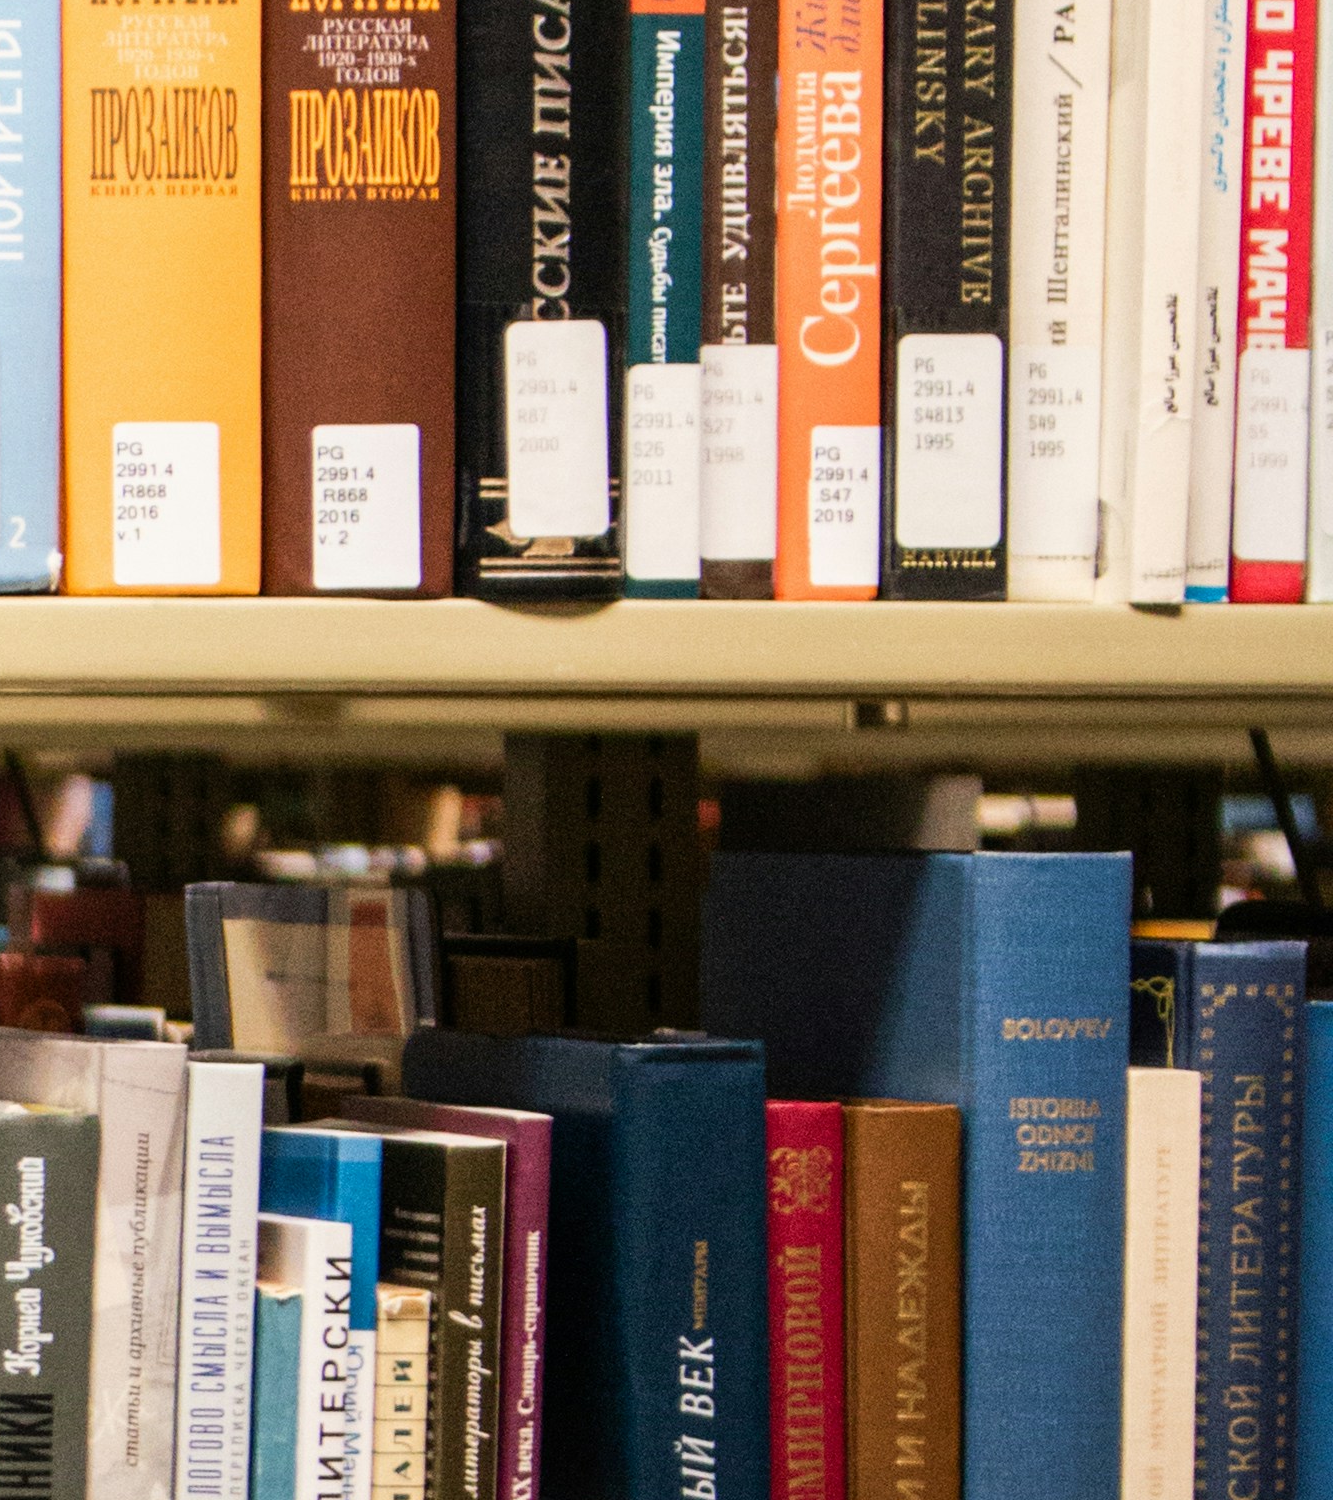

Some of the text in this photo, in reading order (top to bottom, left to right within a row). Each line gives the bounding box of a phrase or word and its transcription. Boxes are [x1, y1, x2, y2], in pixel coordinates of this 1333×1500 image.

[302, 33, 430, 51] ЛИТЕРАТУРА
[322, 17, 412, 33] РУССКАЯ
[334, 67, 401, 84] ГОДОВ
[90, 85, 239, 182] ПРОЗАИКОВ
[290, 88, 441, 186] ПРОЗАИКОВ
[649, 29, 683, 159] Империя
[785, 71, 819, 219] Людмила
[1249, 50, 1294, 212] ЧРЕВЕ
[291, 187, 440, 200] КНИГА ВТОРАЯ
[799, 70, 877, 367] Сергеева
[960, 116, 995, 306] ARCHIVE
[1046, 93, 1074, 306] Шенталинский
[913, 432, 956, 452] 1995
[116, 505, 160, 522] 2016
[316, 508, 360, 525] 2016
[813, 507, 855, 524] 2019
[128, 1131, 152, 1258] публикации
[1228, 1074, 1267, 1367] ЛИТЕРАТУРЫ
[3, 1155, 56, 1377] Корней Чуковский
[464, 1204, 489, 1307] письмах
[187, 1133, 234, 1496] ЛОГОВО СМЫСЛА ВЫМЫСЛА
[458, 1338, 493, 1500] литераторы
[679, 1334, 716, 1418] ВЕК
